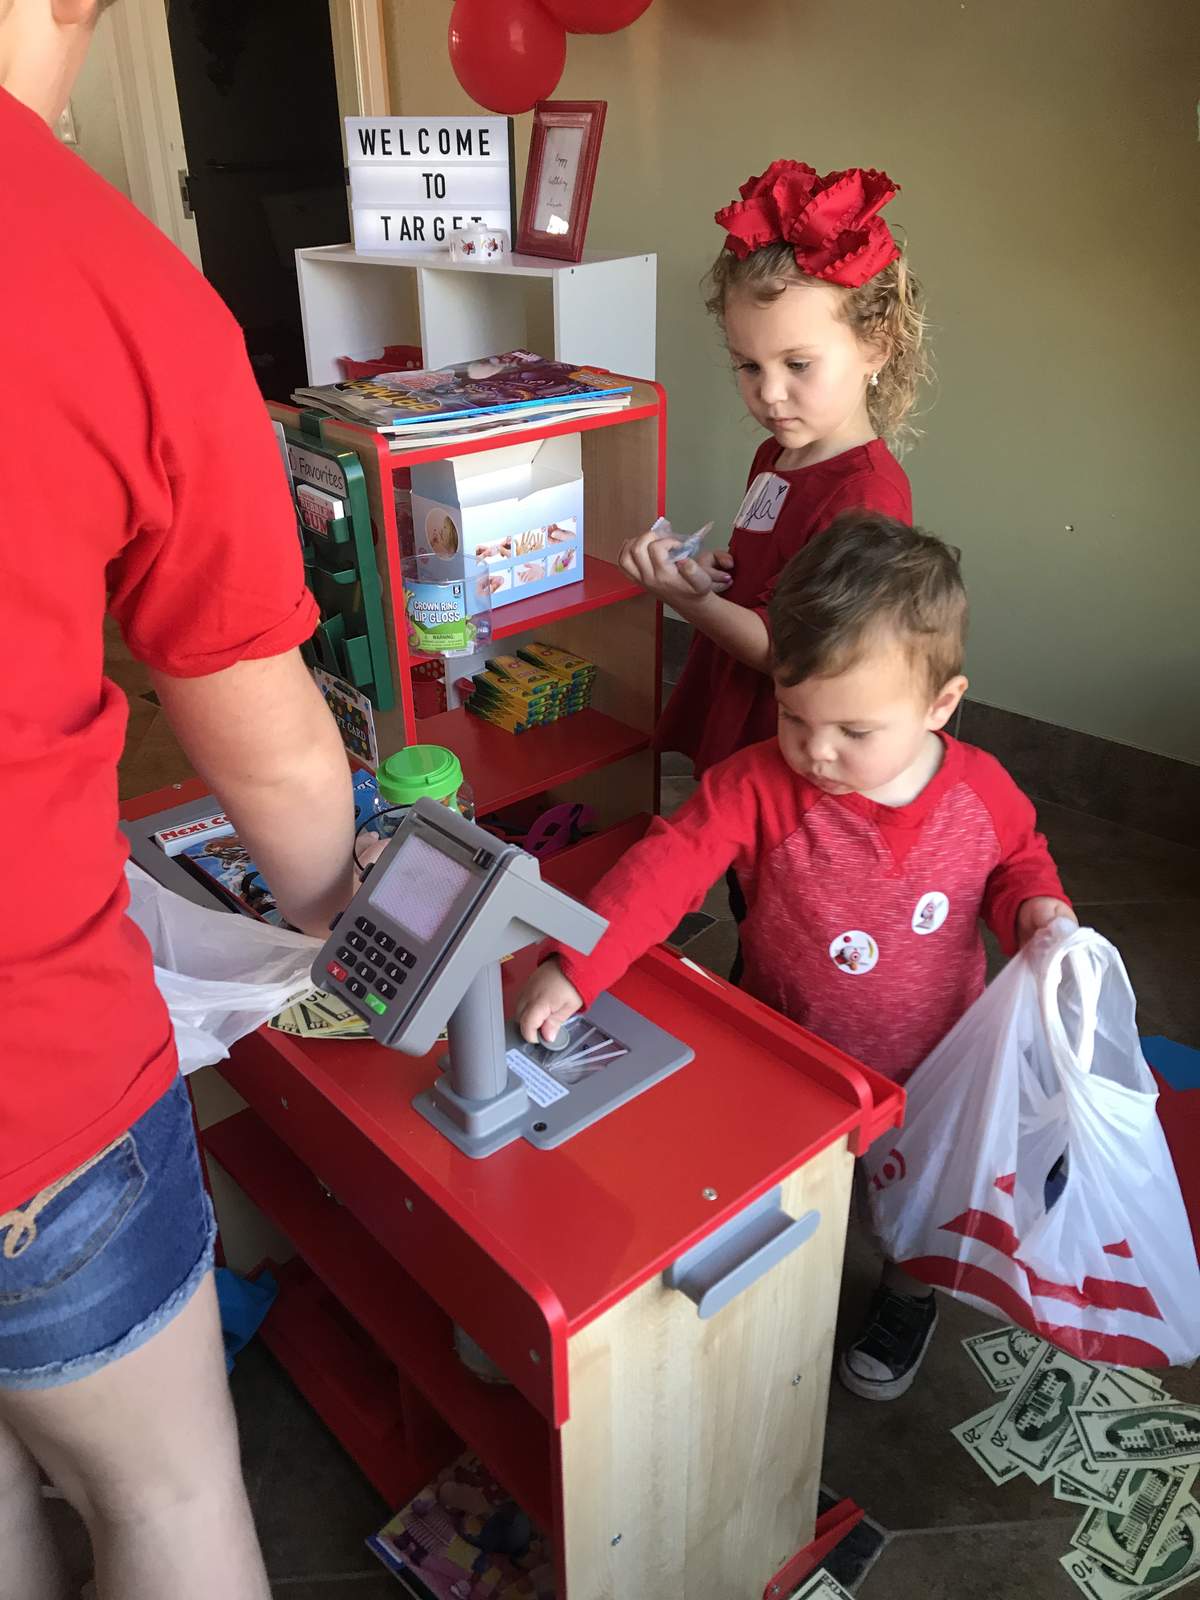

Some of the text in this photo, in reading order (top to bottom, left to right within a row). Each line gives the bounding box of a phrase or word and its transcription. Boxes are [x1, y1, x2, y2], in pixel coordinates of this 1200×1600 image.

[358, 128, 490, 156] WELCOME
[422, 173, 446, 199] TO
[381, 216, 482, 241] TARGE
[299, 457, 344, 490] Favorites
[414, 601, 458, 612] CROWN RING
[414, 612, 461, 623] LIP GLOSS
[160, 822, 208, 840] Next
[361, 921, 408, 961] 1 2 3
[351, 937, 398, 977] 4 5 6
[341, 951, 388, 992] 7 8 9
[351, 983, 358, 992] 0
[962, 1427, 981, 1444] 20
[990, 1430, 1008, 1447] 20
[1071, 1559, 1093, 1579] 10
